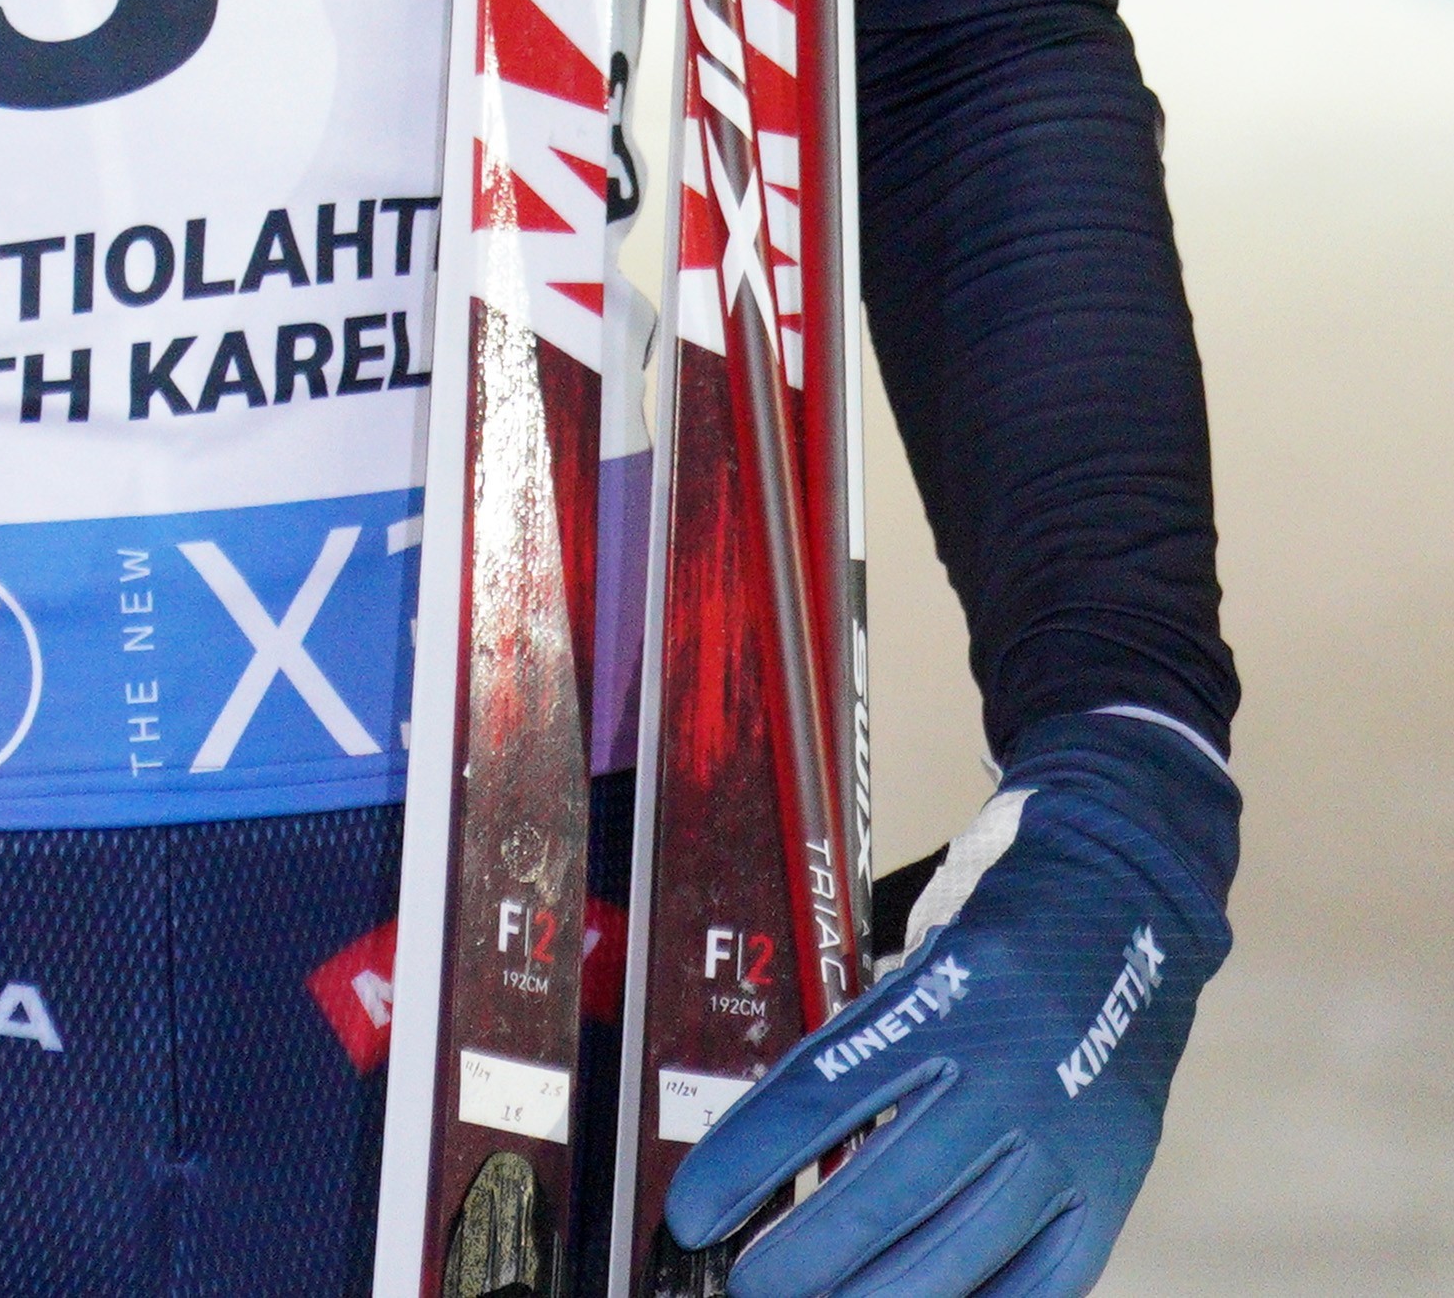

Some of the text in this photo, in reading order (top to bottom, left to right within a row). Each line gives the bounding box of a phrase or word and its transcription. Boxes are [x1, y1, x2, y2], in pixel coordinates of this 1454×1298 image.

[127, 311, 434, 422] KAREL
[120, 547, 164, 777] THE NEW
[175, 520, 415, 776] X
[805, 838, 847, 992] TRIAC
[501, 969, 550, 996] 192CM
[708, 994, 767, 1018] 192CM
